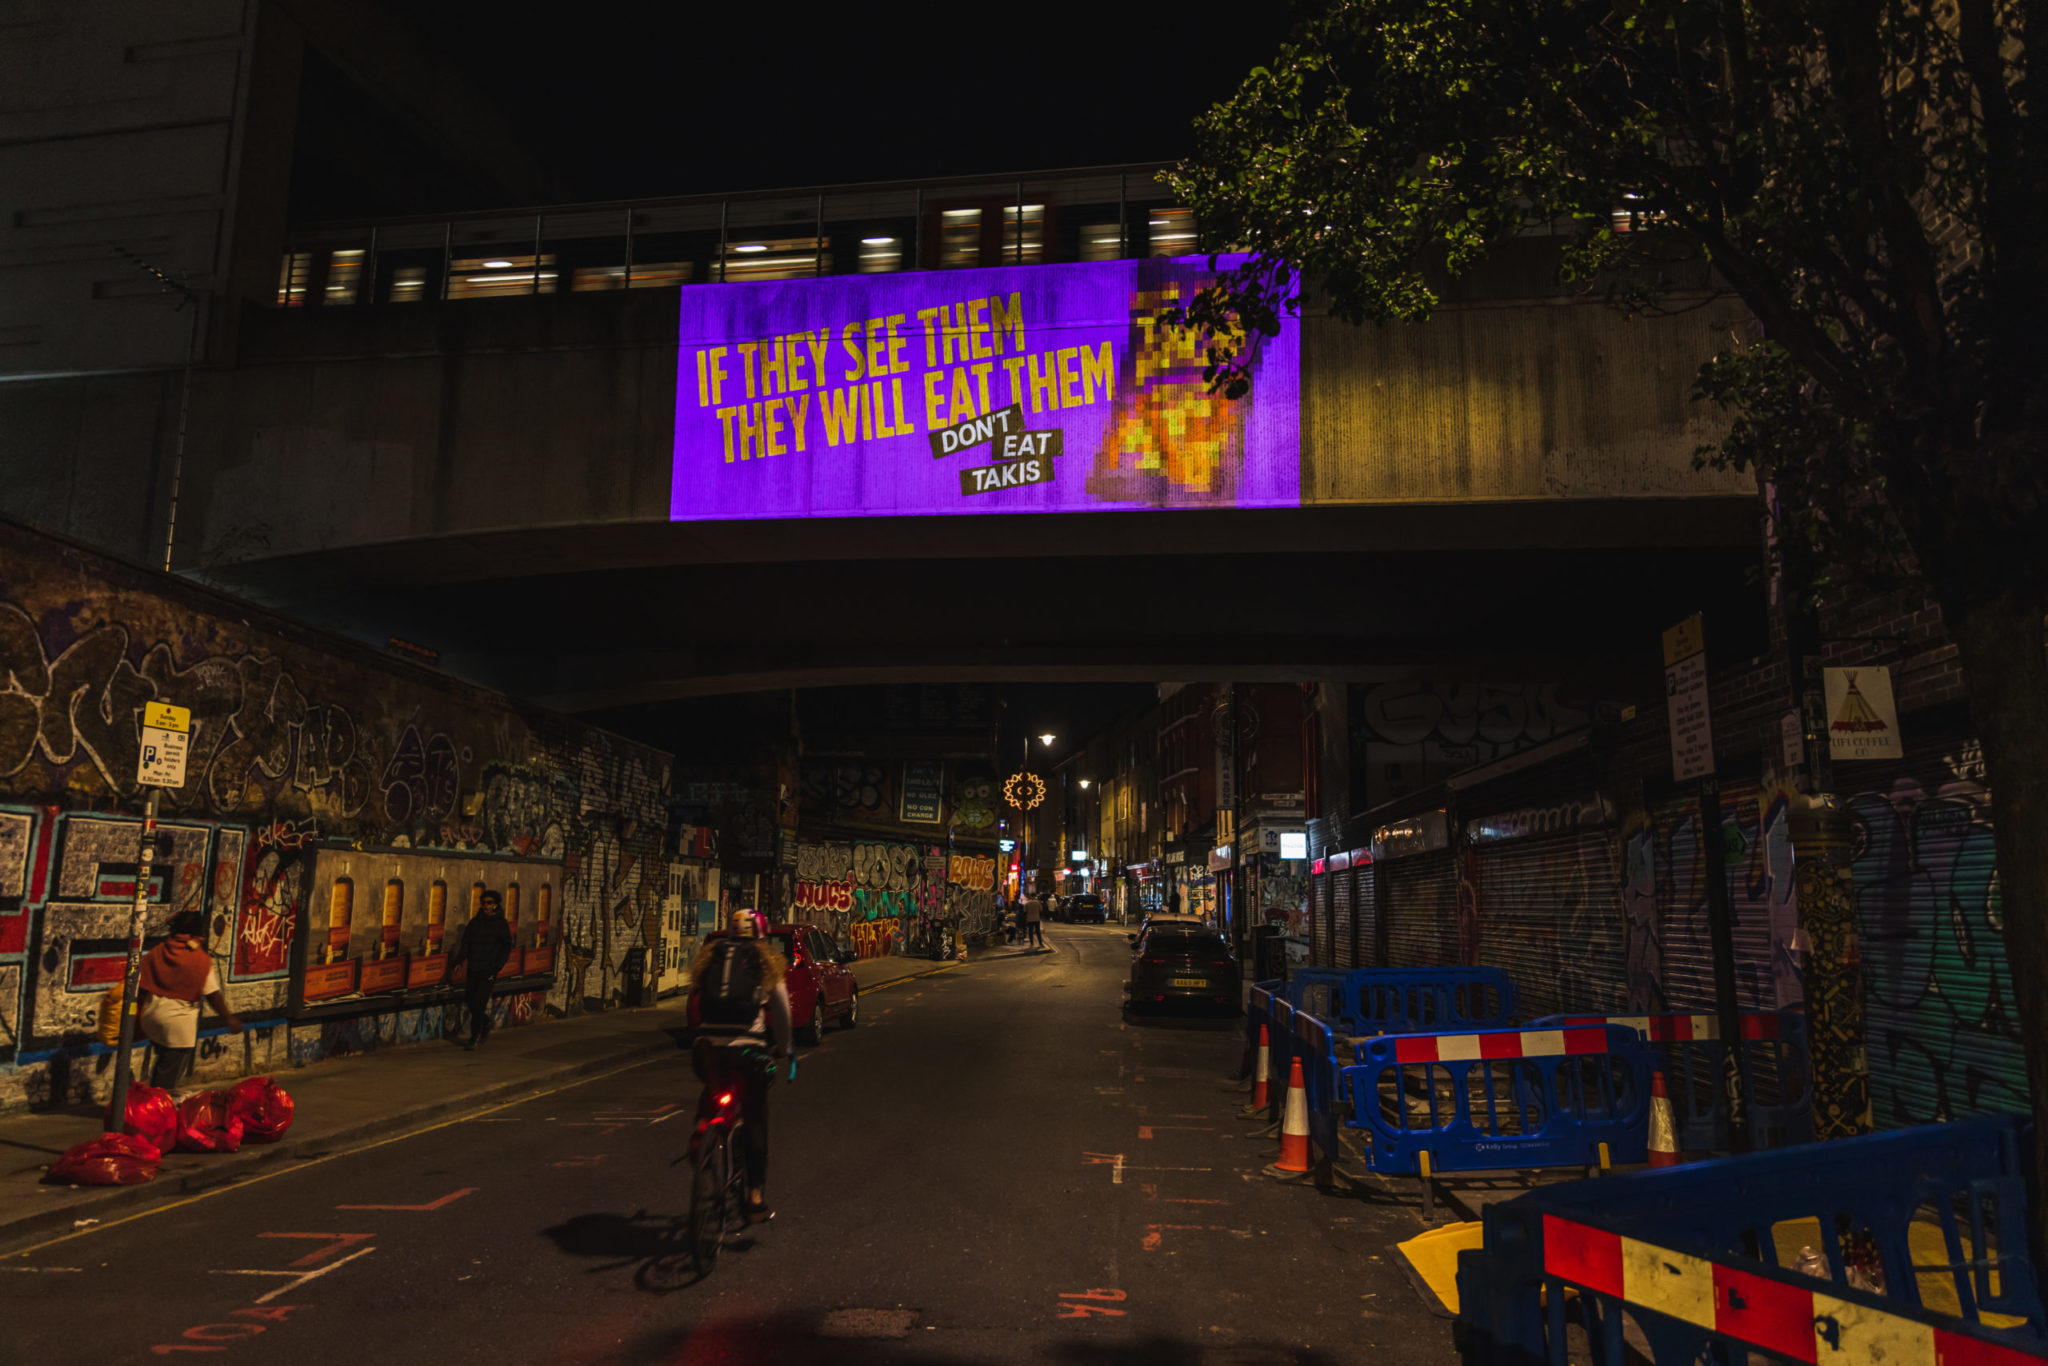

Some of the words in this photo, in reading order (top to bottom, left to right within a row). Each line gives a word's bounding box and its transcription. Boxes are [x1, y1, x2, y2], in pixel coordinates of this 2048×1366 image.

[697, 346, 728, 407] IF
[738, 328, 829, 398] THEY
[843, 314, 909, 381] SEE
[917, 292, 1025, 367] THEM
[717, 394, 809, 463] THEY
[819, 378, 914, 446] WILL
[924, 362, 993, 430] EAT
[1003, 341, 1115, 415] THEM
[942, 409, 1011, 453] DON'T
[1003, 433, 1052, 457] EAT
[972, 460, 1040, 491] TAKIS
[145, 747, 155, 761] P
[906, 811, 934, 819] CHARGE
